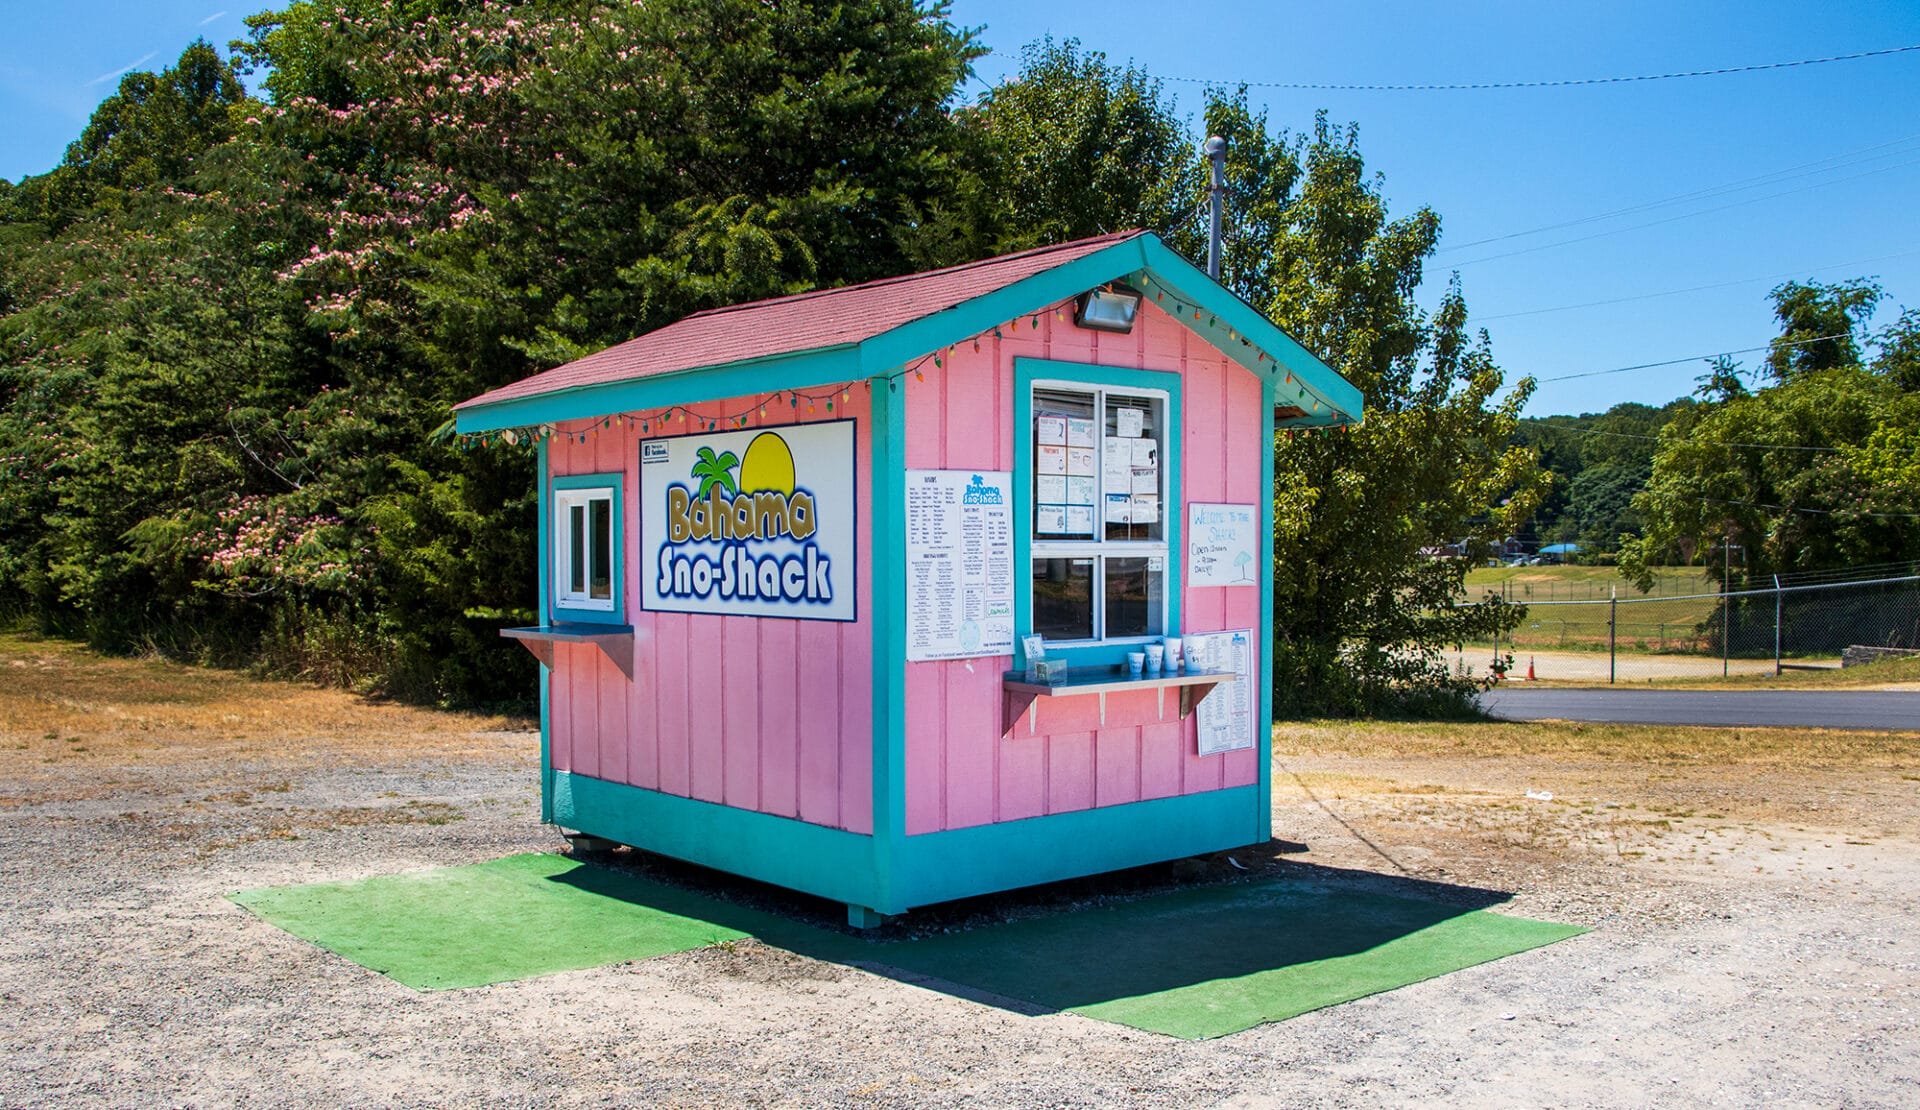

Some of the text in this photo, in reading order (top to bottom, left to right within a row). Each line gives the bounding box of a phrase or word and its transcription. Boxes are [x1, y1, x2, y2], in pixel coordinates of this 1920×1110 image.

[963, 494, 1004, 505] Sno-Shack
[966, 484, 1000, 496] Bahama
[669, 486, 817, 543] Bahama
[659, 545, 832, 599] Sno-Shack
